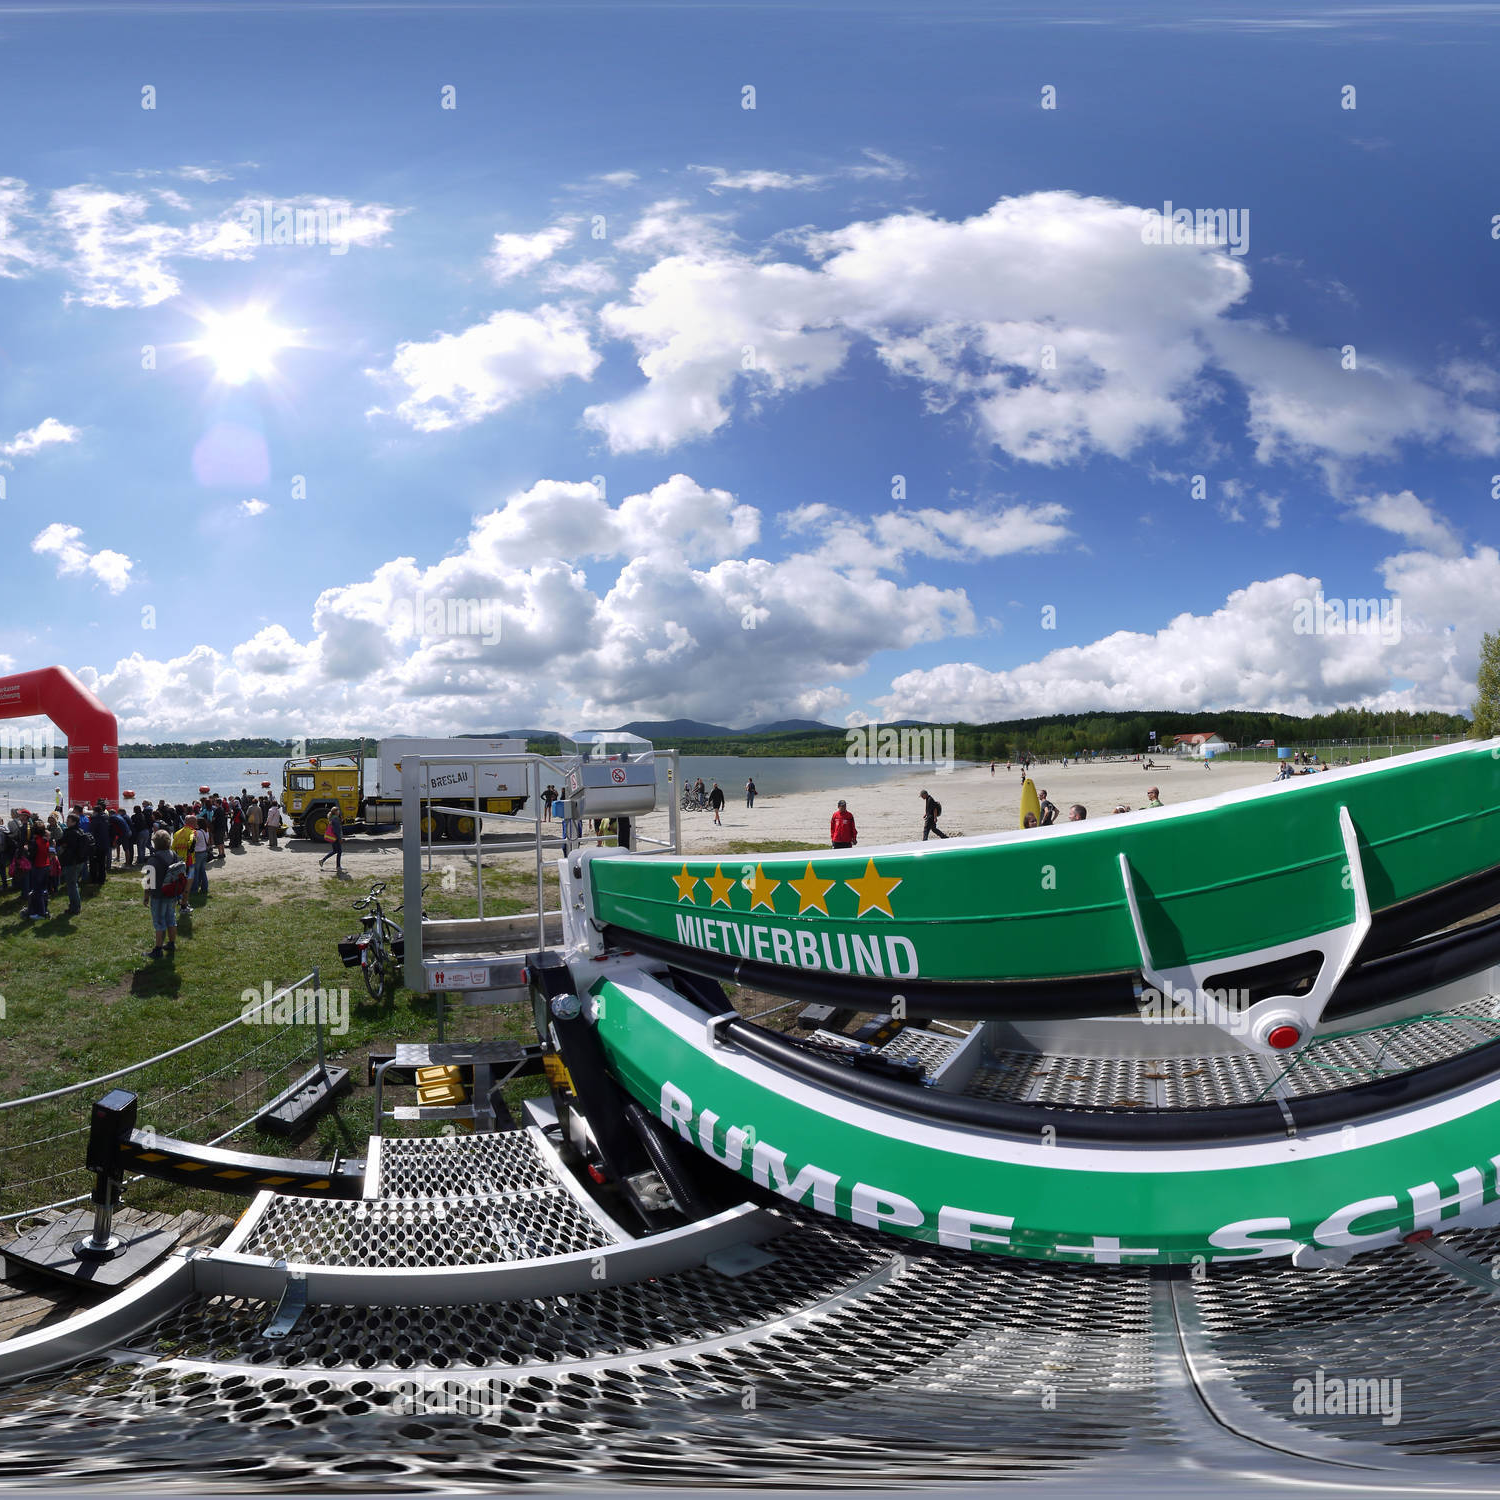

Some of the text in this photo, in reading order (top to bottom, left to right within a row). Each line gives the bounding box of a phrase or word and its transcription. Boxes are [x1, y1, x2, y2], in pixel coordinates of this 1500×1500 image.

[431, 771, 468, 789] BRESLAU
[675, 913, 919, 979] MIETVERBUND
[660, 1080, 1015, 1251] RUMPF
[1207, 1153, 1500, 1264] SCH
